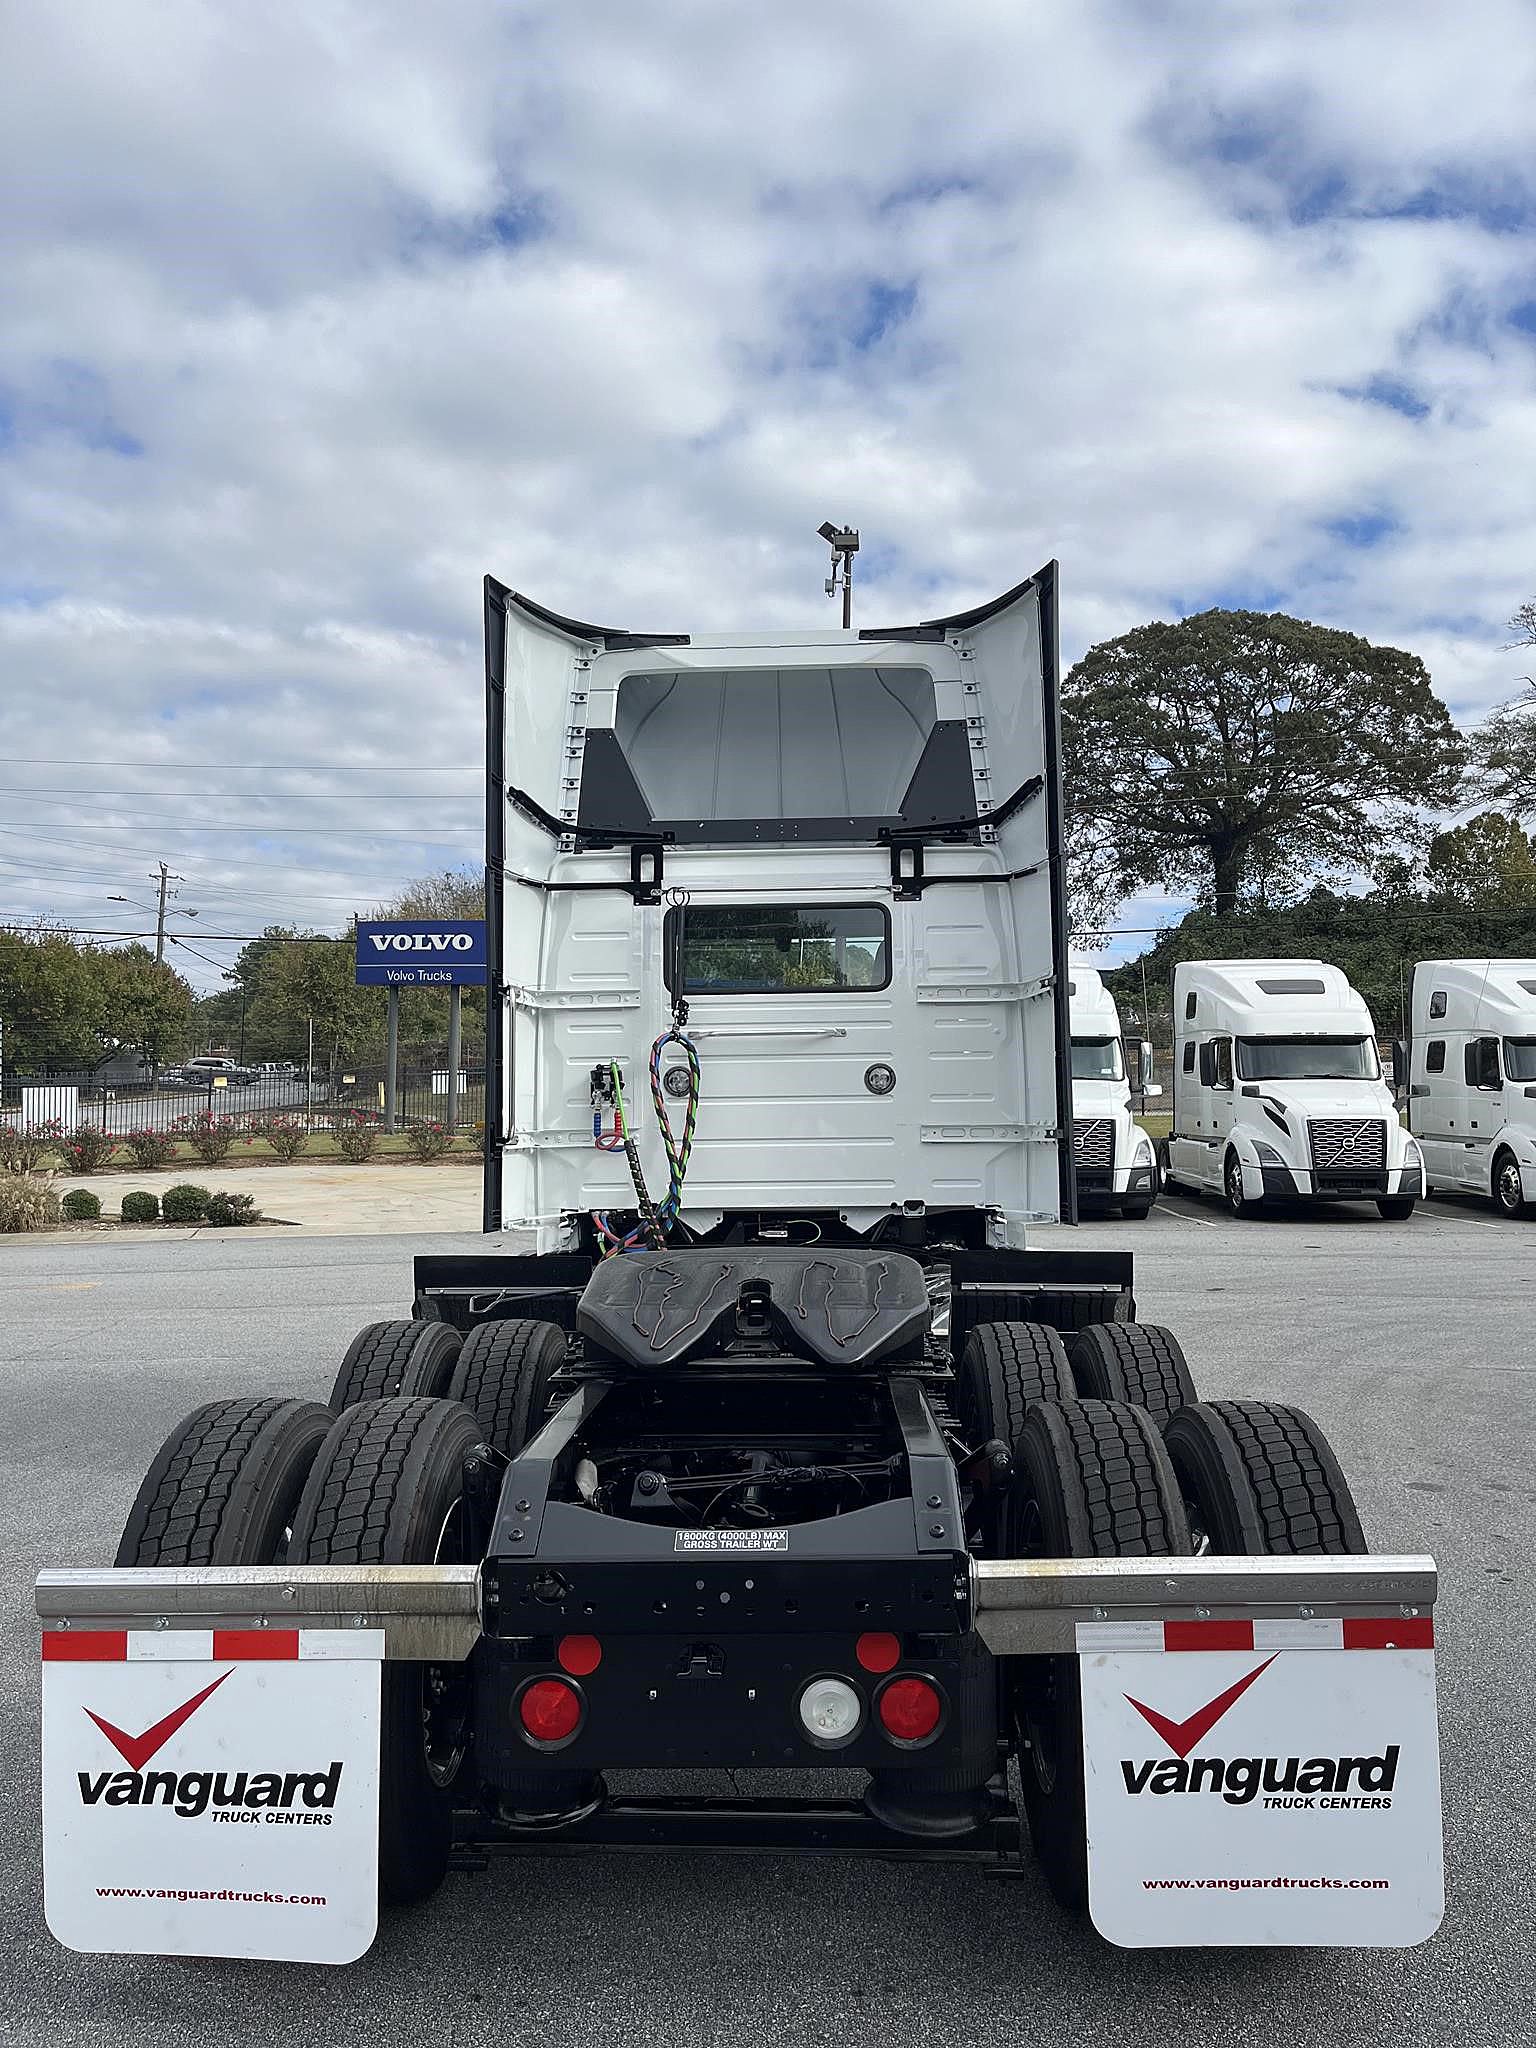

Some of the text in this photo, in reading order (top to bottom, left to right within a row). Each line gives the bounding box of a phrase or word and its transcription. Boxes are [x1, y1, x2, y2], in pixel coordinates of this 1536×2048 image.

[369, 934, 473, 951] VOLVO
[387, 970, 453, 981] Volvo Trucks
[678, 1531, 786, 1541] 1800KG (4000LB) MAX
[683, 1540, 779, 1549] GROSS TRAILER WT
[1120, 1745, 1401, 1805] vanguard
[77, 1762, 344, 1818] vanguard
[1263, 1797, 1392, 1809] TRUCK CENTERS
[211, 1811, 333, 1826] TRUCK CENTERS
[1142, 1877, 1390, 1891] www.vanguardtrucks.com
[96, 1887, 327, 1906] www.vanguardtrucks.com
